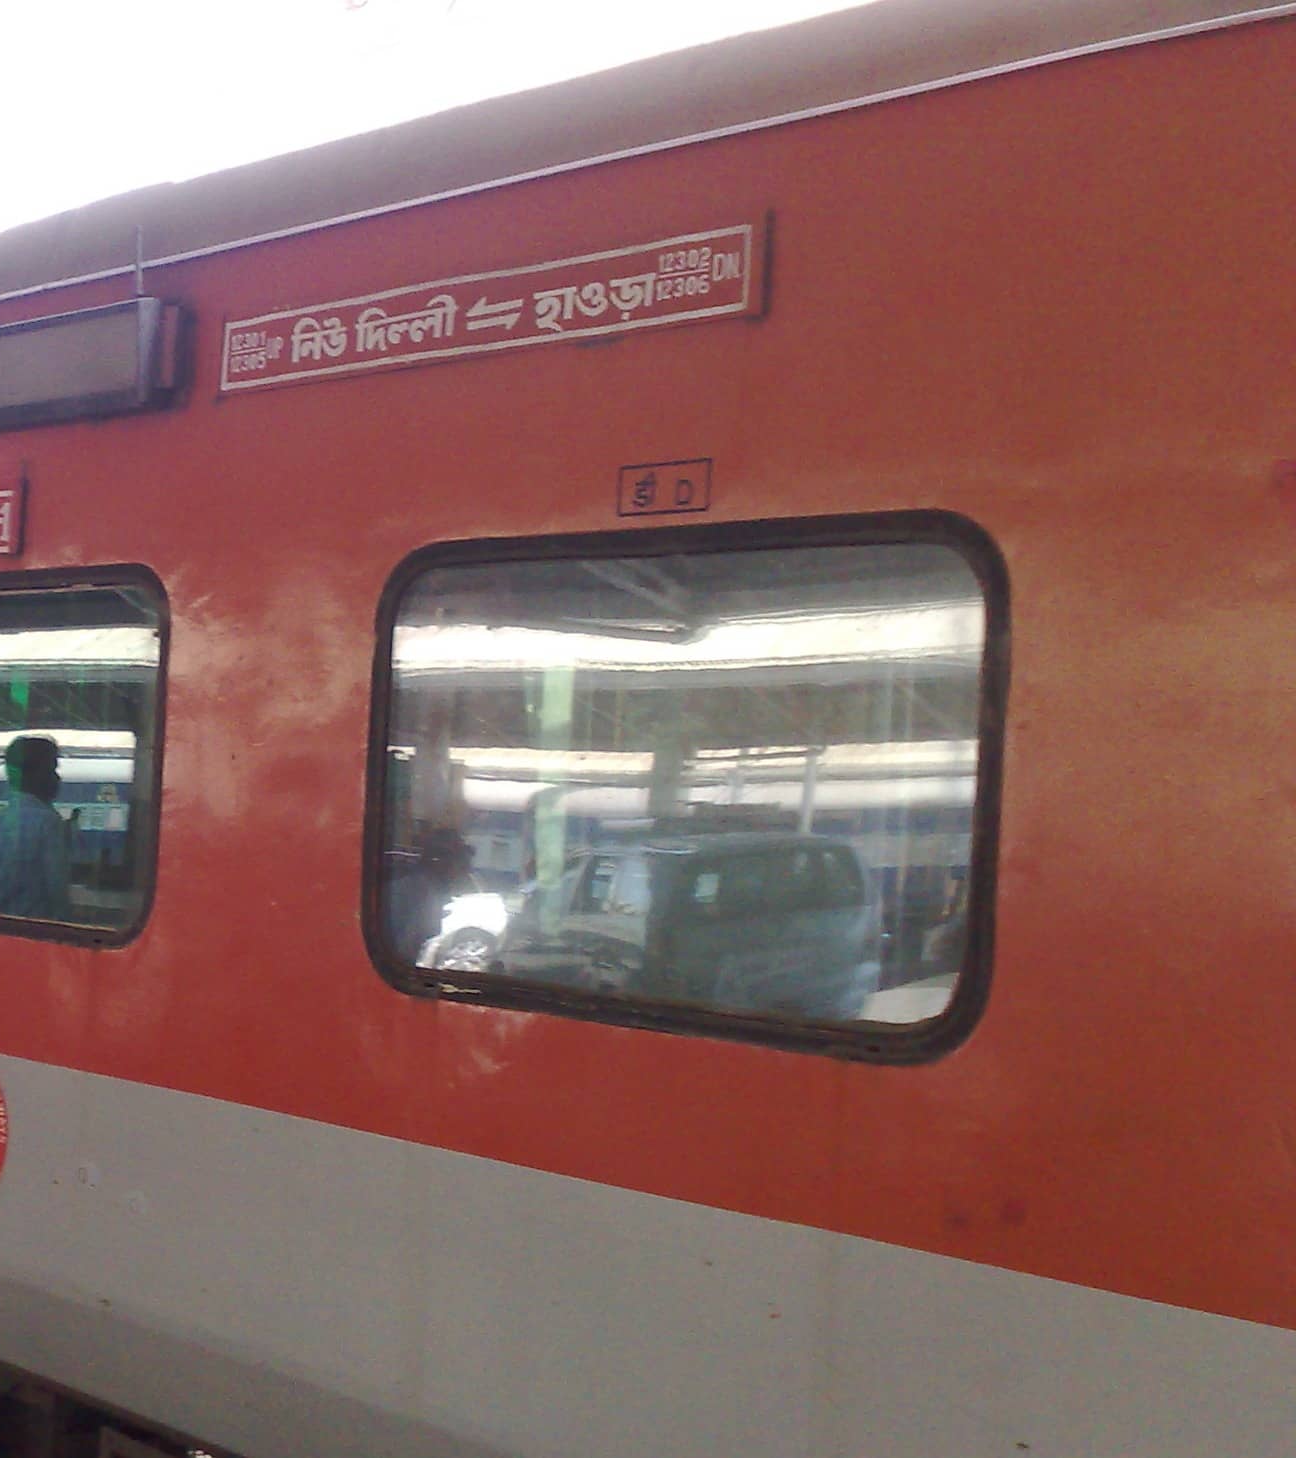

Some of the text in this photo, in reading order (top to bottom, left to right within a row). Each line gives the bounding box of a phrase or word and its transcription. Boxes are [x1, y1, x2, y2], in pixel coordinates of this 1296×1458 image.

[659, 247, 712, 273] 12302
[712, 252, 743, 281] DN
[656, 274, 710, 302] 12306
[291, 272, 658, 362] নিউ দিল্লী হাওড়া
[675, 479, 694, 505] D
